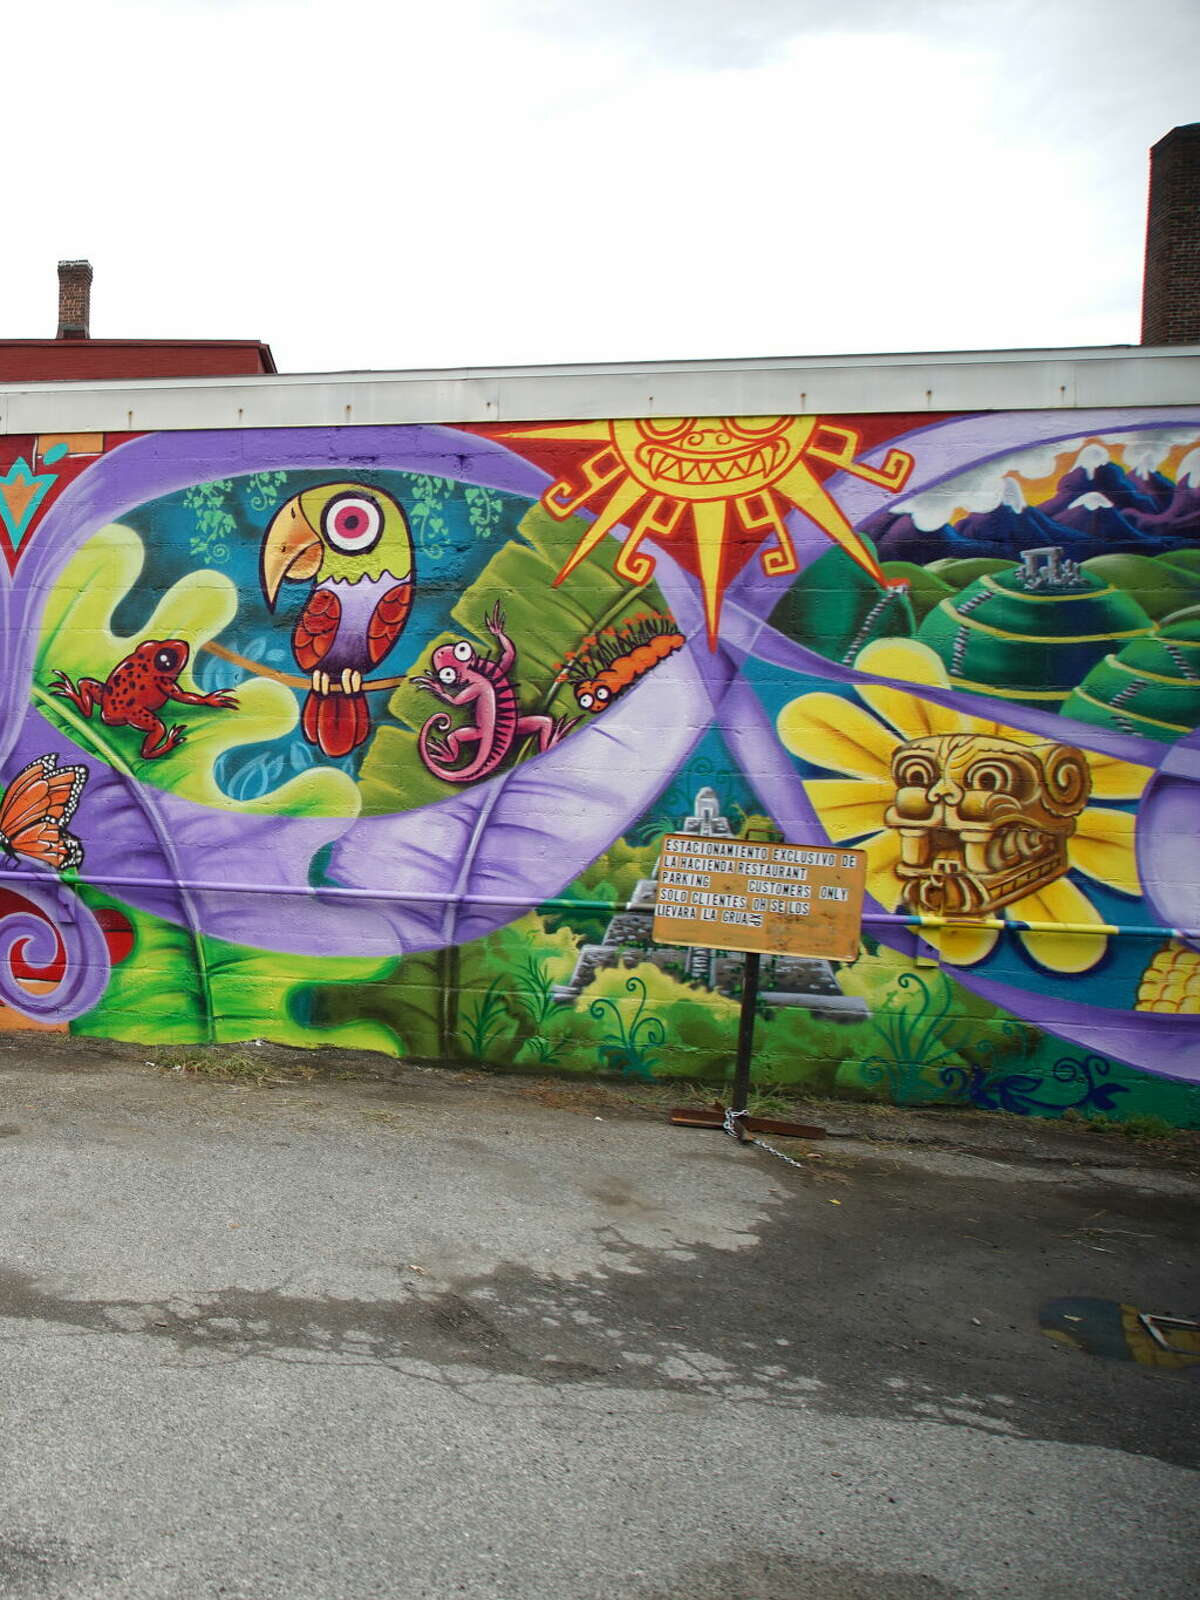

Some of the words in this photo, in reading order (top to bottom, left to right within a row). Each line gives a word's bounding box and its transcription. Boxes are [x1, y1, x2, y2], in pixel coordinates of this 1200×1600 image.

[665, 839, 768, 860] ESTACIONAMIENTO
[773, 848, 836, 866] EXCLUSIVO
[841, 855, 856, 867] DE
[664, 856, 677, 867] LA
[680, 858, 734, 873] HACIENDA
[738, 862, 806, 880] RESTAURANT
[662, 872, 710, 887] PARKING
[749, 880, 810, 898] CUSTOMERS
[821, 887, 848, 901] ONLY
[660, 889, 687, 902] SOLO
[691, 892, 746, 908] CLIENTES
[771, 900, 784, 912] SE
[789, 902, 809, 914] LOS
[703, 908, 716, 920] LA
[723, 911, 748, 925] GRUA
